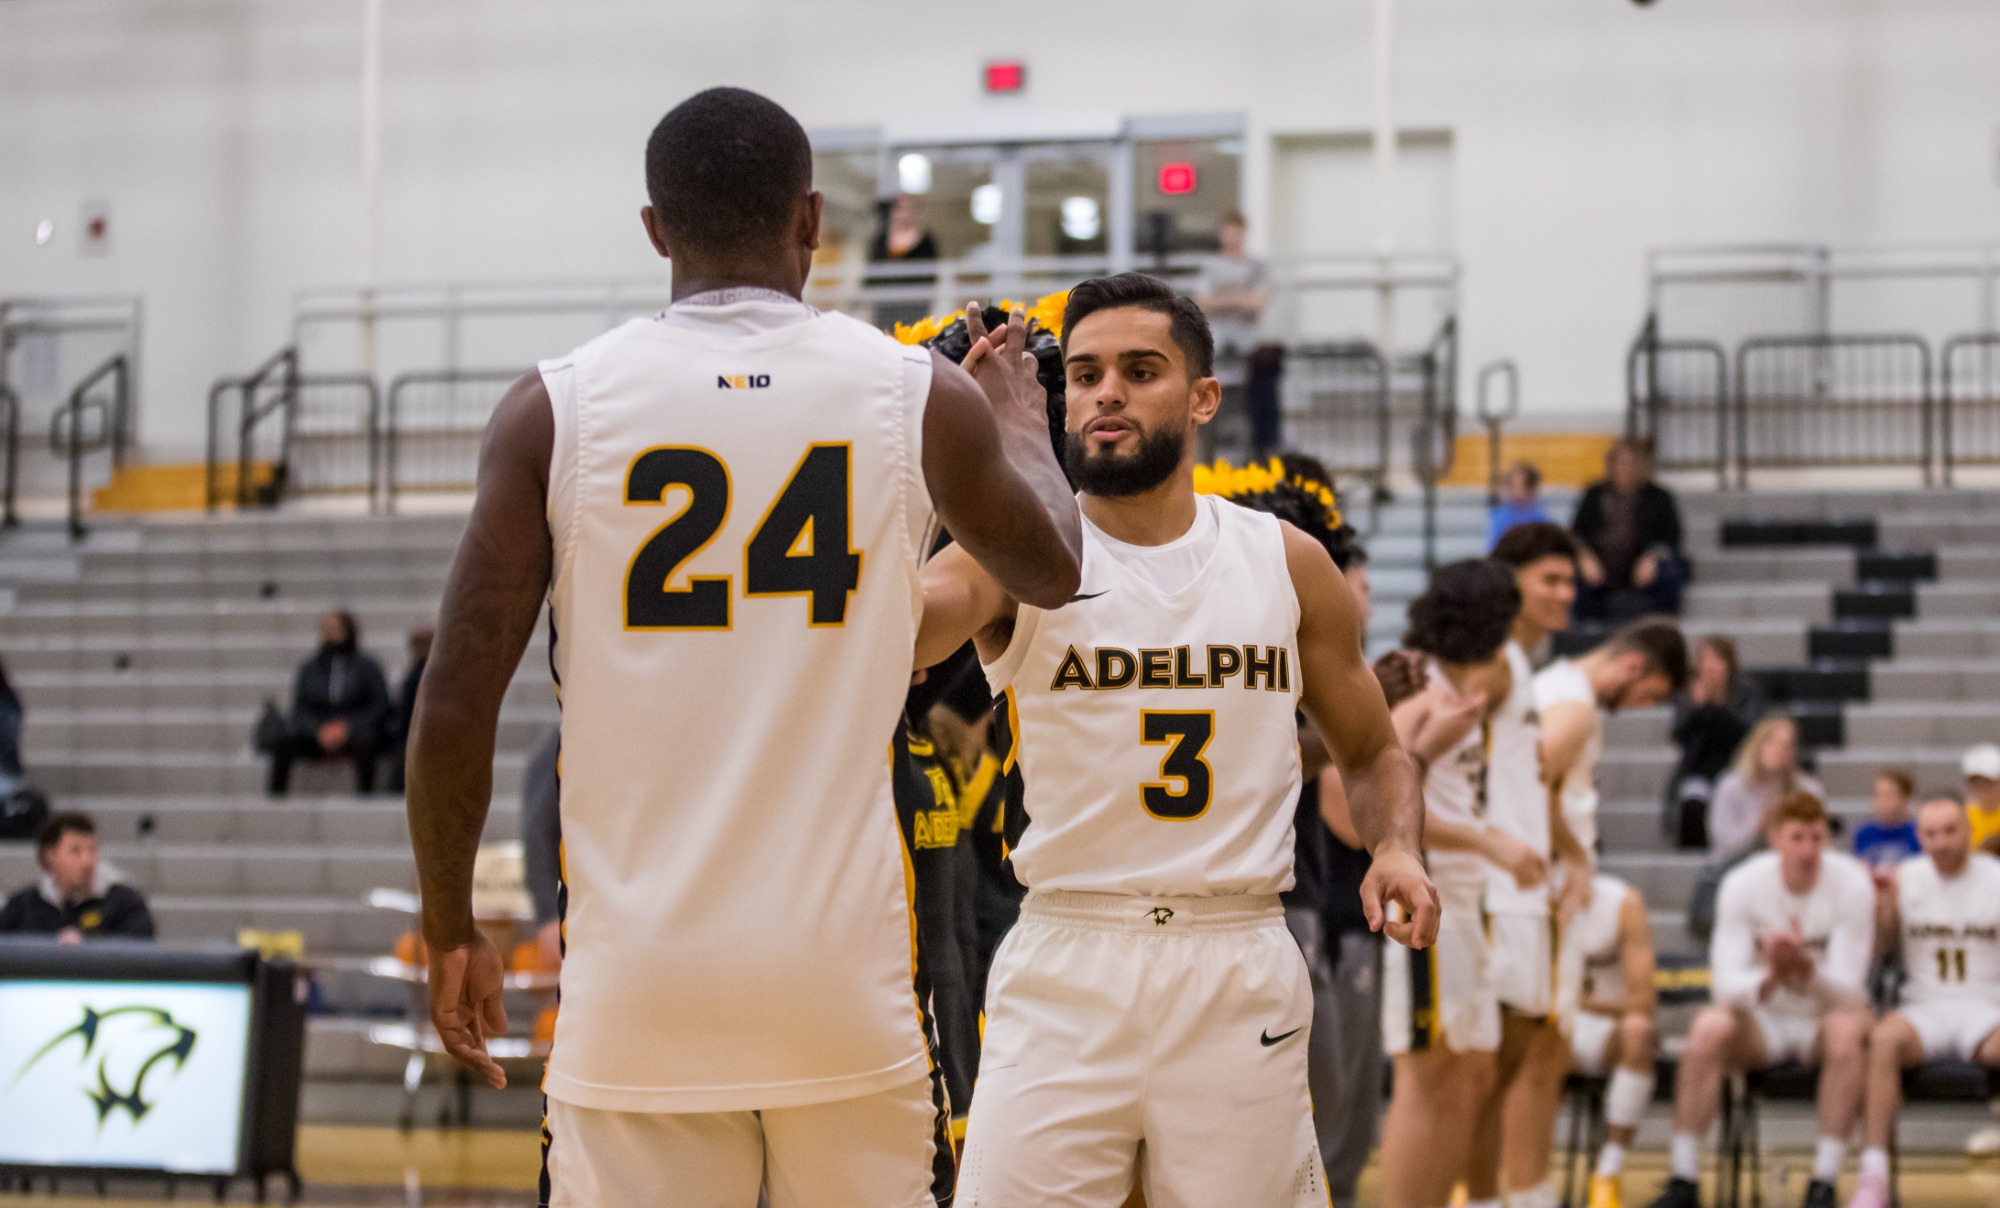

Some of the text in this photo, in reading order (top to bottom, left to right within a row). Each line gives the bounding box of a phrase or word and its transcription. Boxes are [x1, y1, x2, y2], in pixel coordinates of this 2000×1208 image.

[717, 374, 771, 389] NE10
[623, 440, 864, 631] 24
[1050, 643, 1291, 692] ADELPHI
[1139, 708, 1215, 822] 3
[1936, 947, 1966, 984] 11
